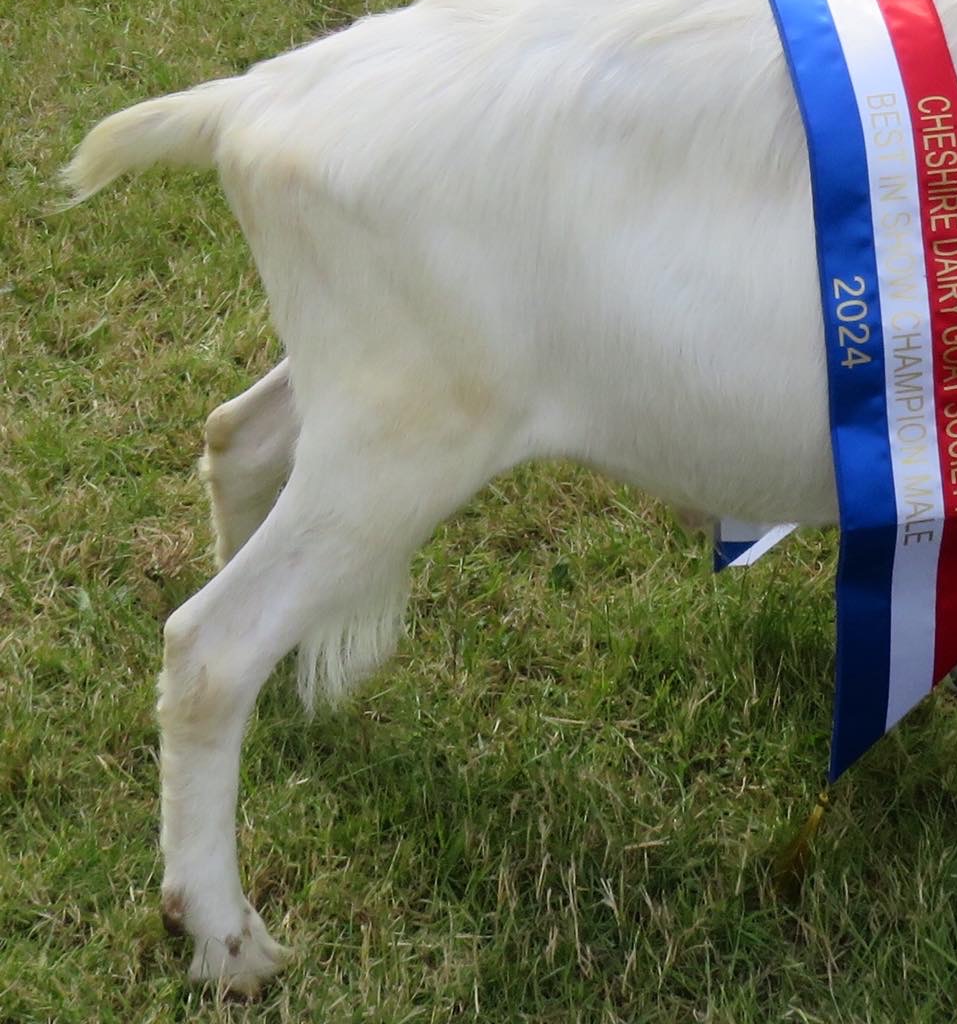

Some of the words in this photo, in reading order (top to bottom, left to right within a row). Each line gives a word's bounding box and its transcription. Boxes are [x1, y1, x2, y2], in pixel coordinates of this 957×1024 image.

[867, 93, 908, 162] BEST
[879, 176, 907, 201] IN
[880, 212, 920, 301] SHOW
[833, 276, 871, 370] 2024
[892, 310, 929, 465] CHAMPION
[903, 476, 935, 547] MALE
